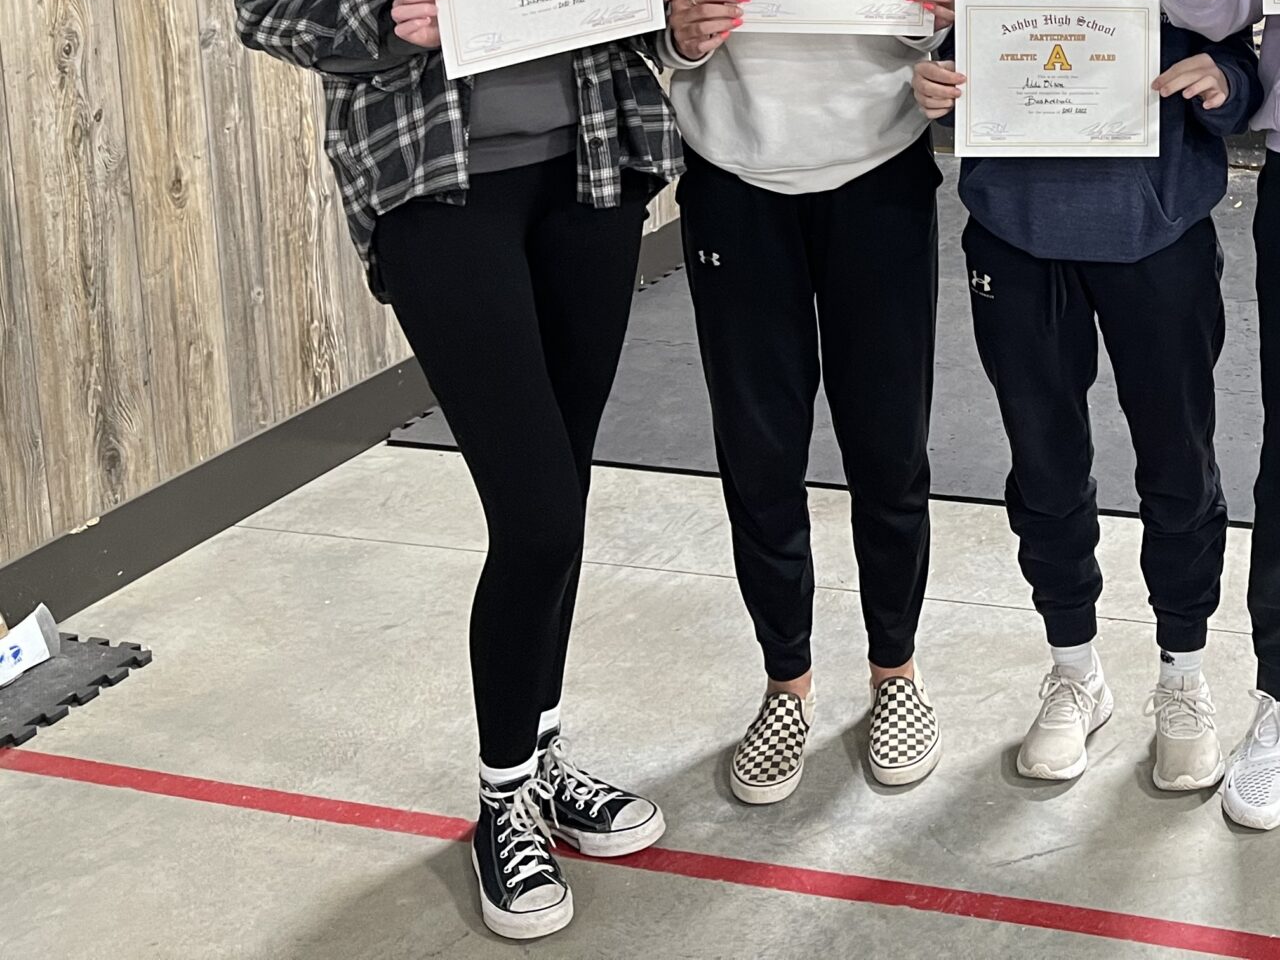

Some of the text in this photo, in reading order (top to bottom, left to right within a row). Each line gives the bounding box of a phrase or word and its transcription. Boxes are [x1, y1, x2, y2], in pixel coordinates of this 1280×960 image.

[1001, 14, 1116, 36] Ashby High School
[1000, 53, 1037, 61] ATHLETIC
[1043, 44, 1072, 71] A
